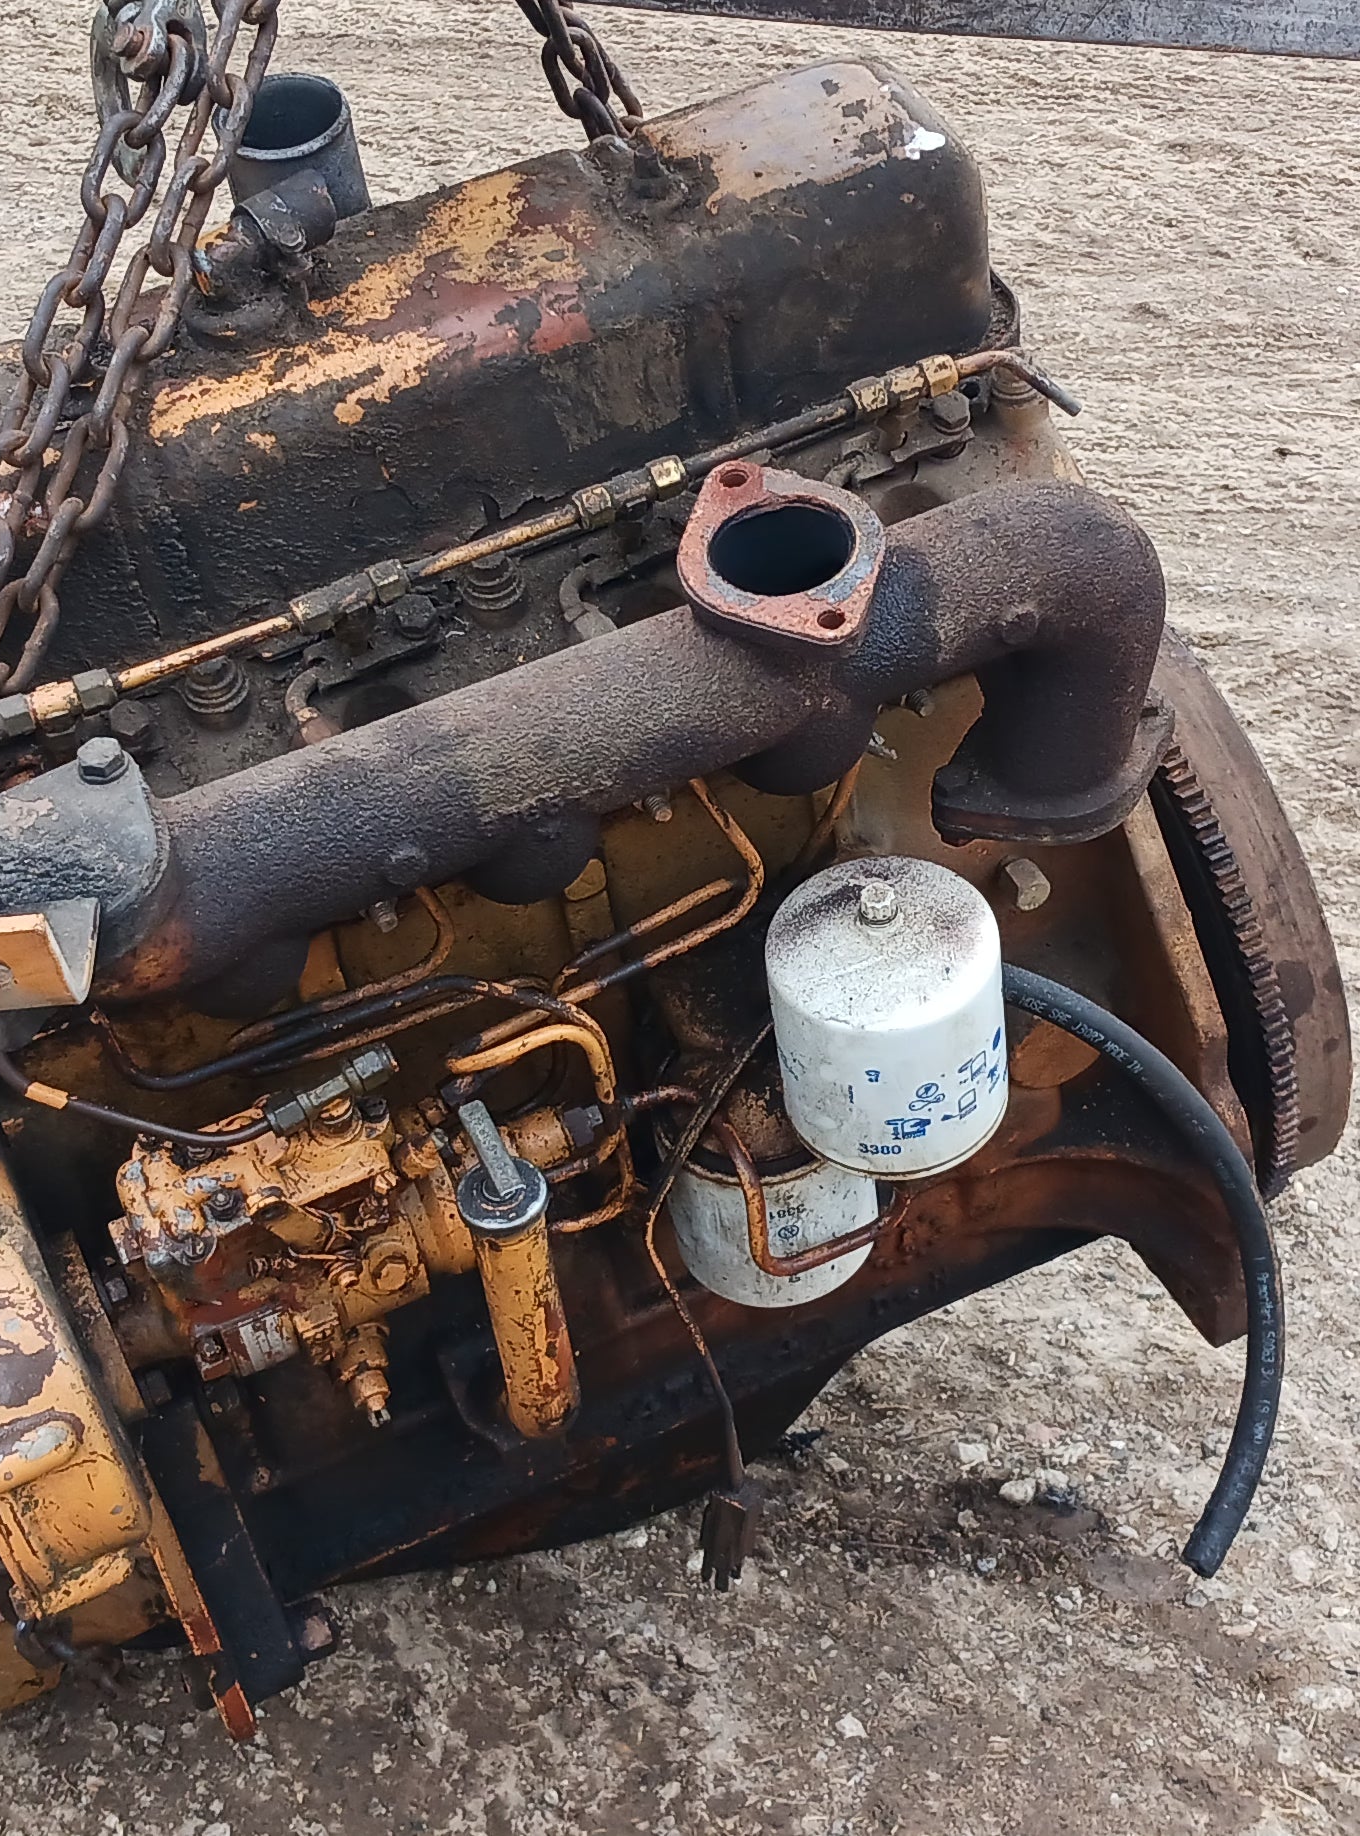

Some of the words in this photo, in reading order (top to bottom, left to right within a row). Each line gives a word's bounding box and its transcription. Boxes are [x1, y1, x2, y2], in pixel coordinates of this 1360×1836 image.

[1019, 995, 1048, 1014] HOSE
[1048, 1008, 1072, 1026] SAE
[1103, 1040, 1130, 1063] MADE
[858, 1143, 902, 1155] 3380
